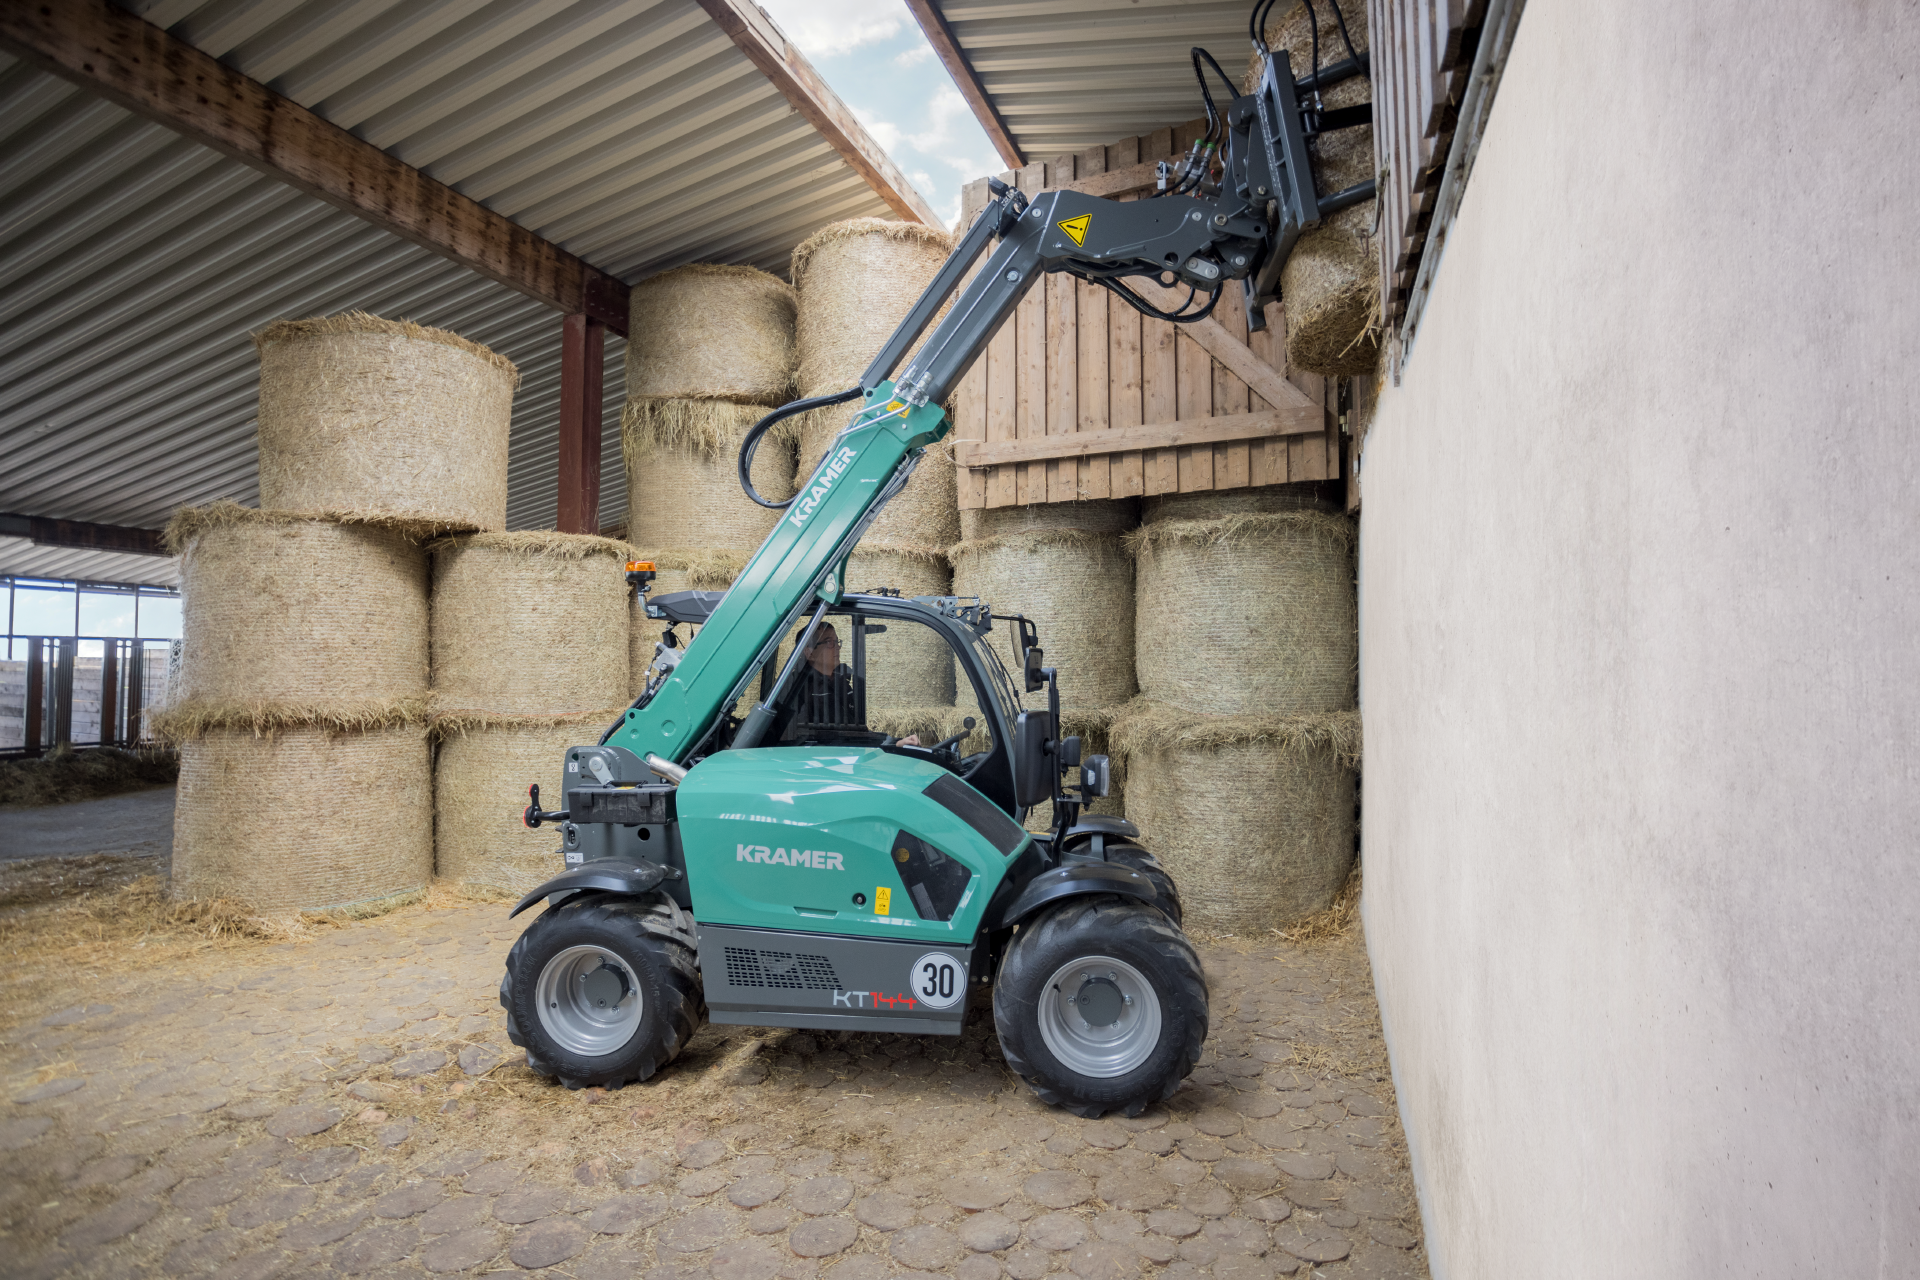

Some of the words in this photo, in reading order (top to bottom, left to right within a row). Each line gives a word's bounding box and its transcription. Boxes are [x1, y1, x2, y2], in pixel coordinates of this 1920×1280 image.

[789, 446, 857, 527] KRAMER
[736, 844, 845, 871] KRAMER
[922, 963, 954, 998] 30
[833, 990, 917, 1009] KT144
